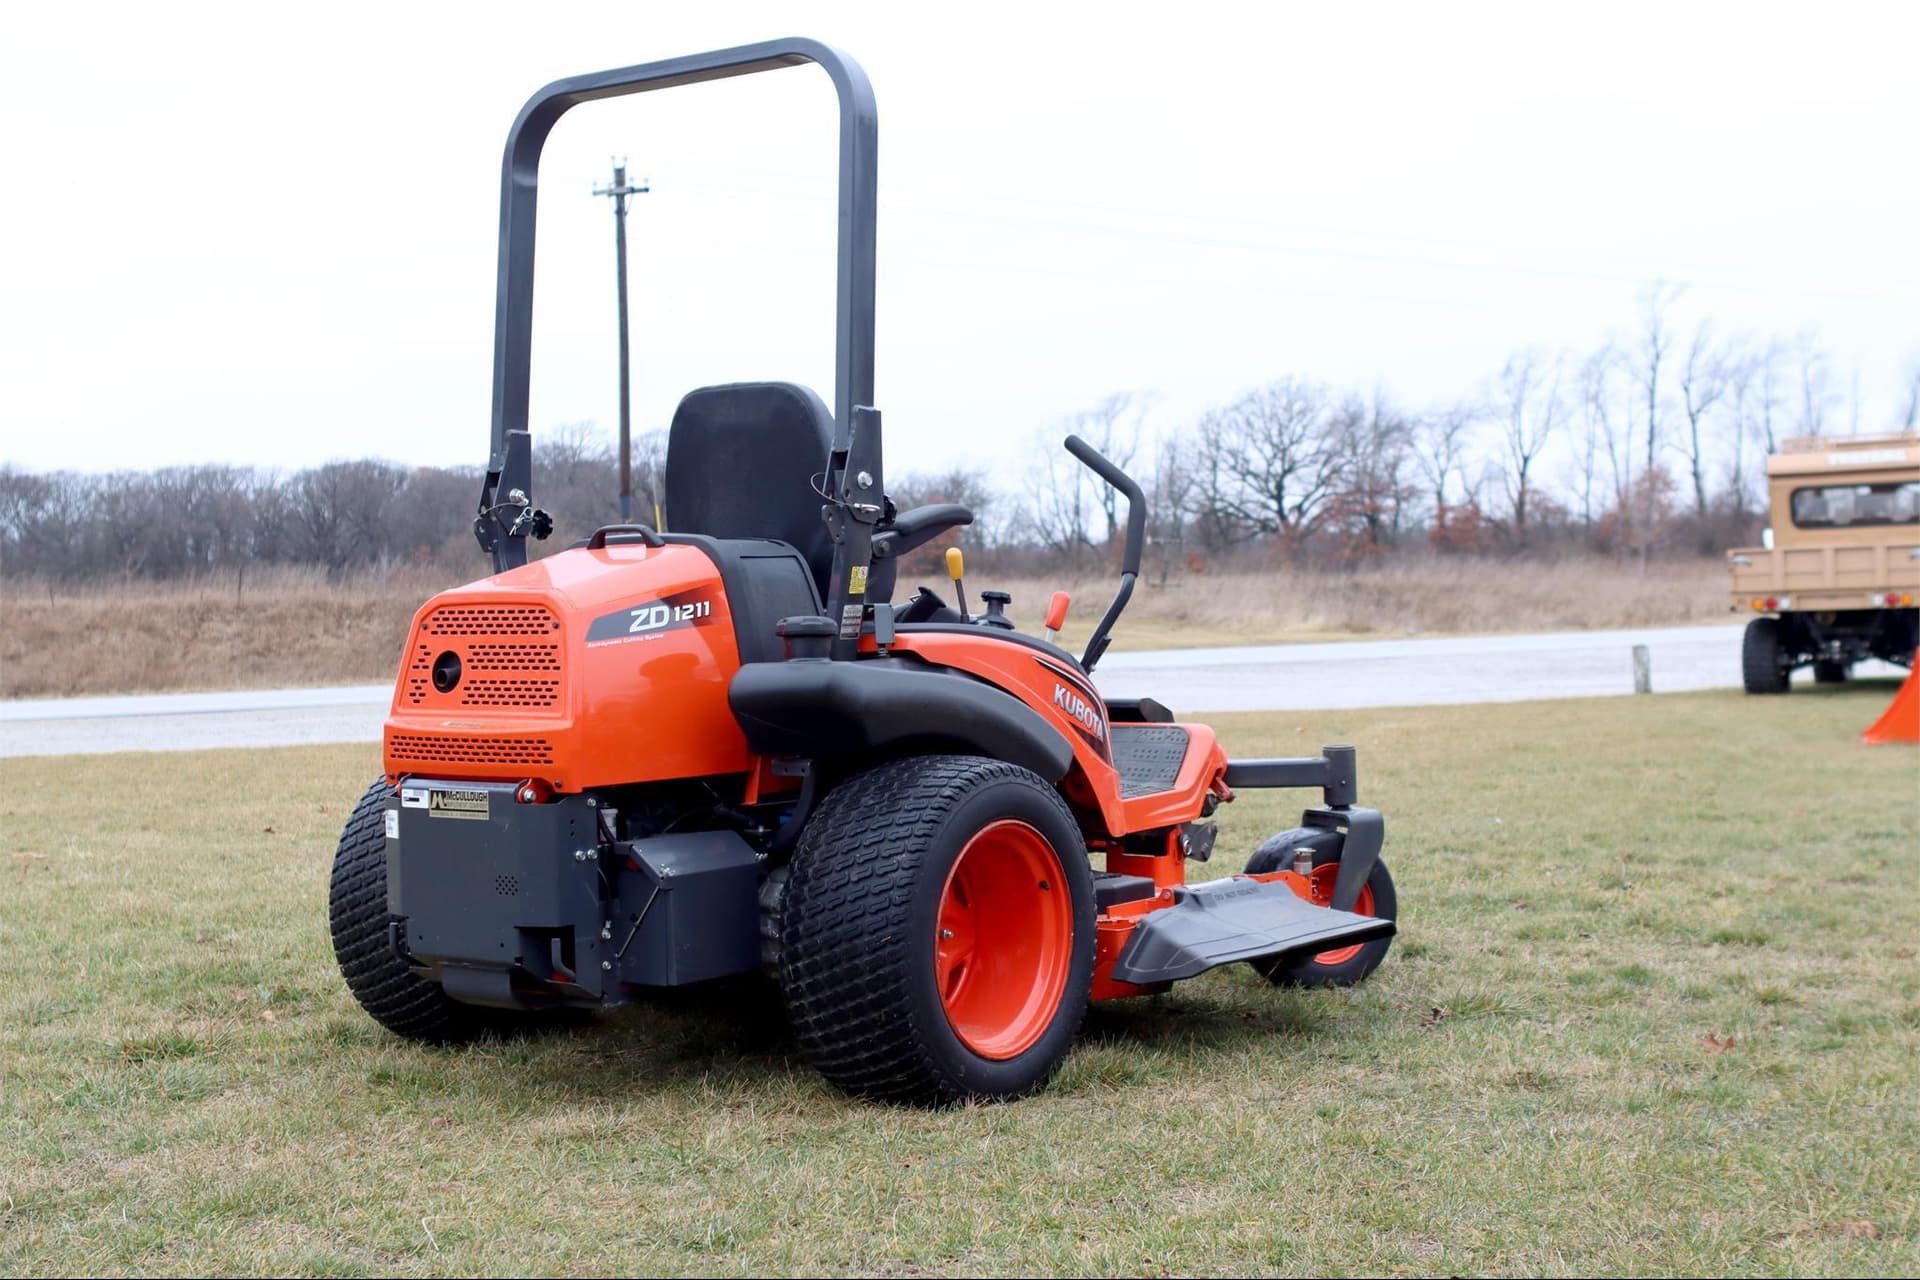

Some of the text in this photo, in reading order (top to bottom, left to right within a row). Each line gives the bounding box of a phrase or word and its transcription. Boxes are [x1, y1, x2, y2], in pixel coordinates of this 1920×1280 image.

[629, 600, 710, 633] ZD 1211
[1053, 683, 1104, 742] KUBOTA
[446, 791, 488, 802] McCULLOUGH
